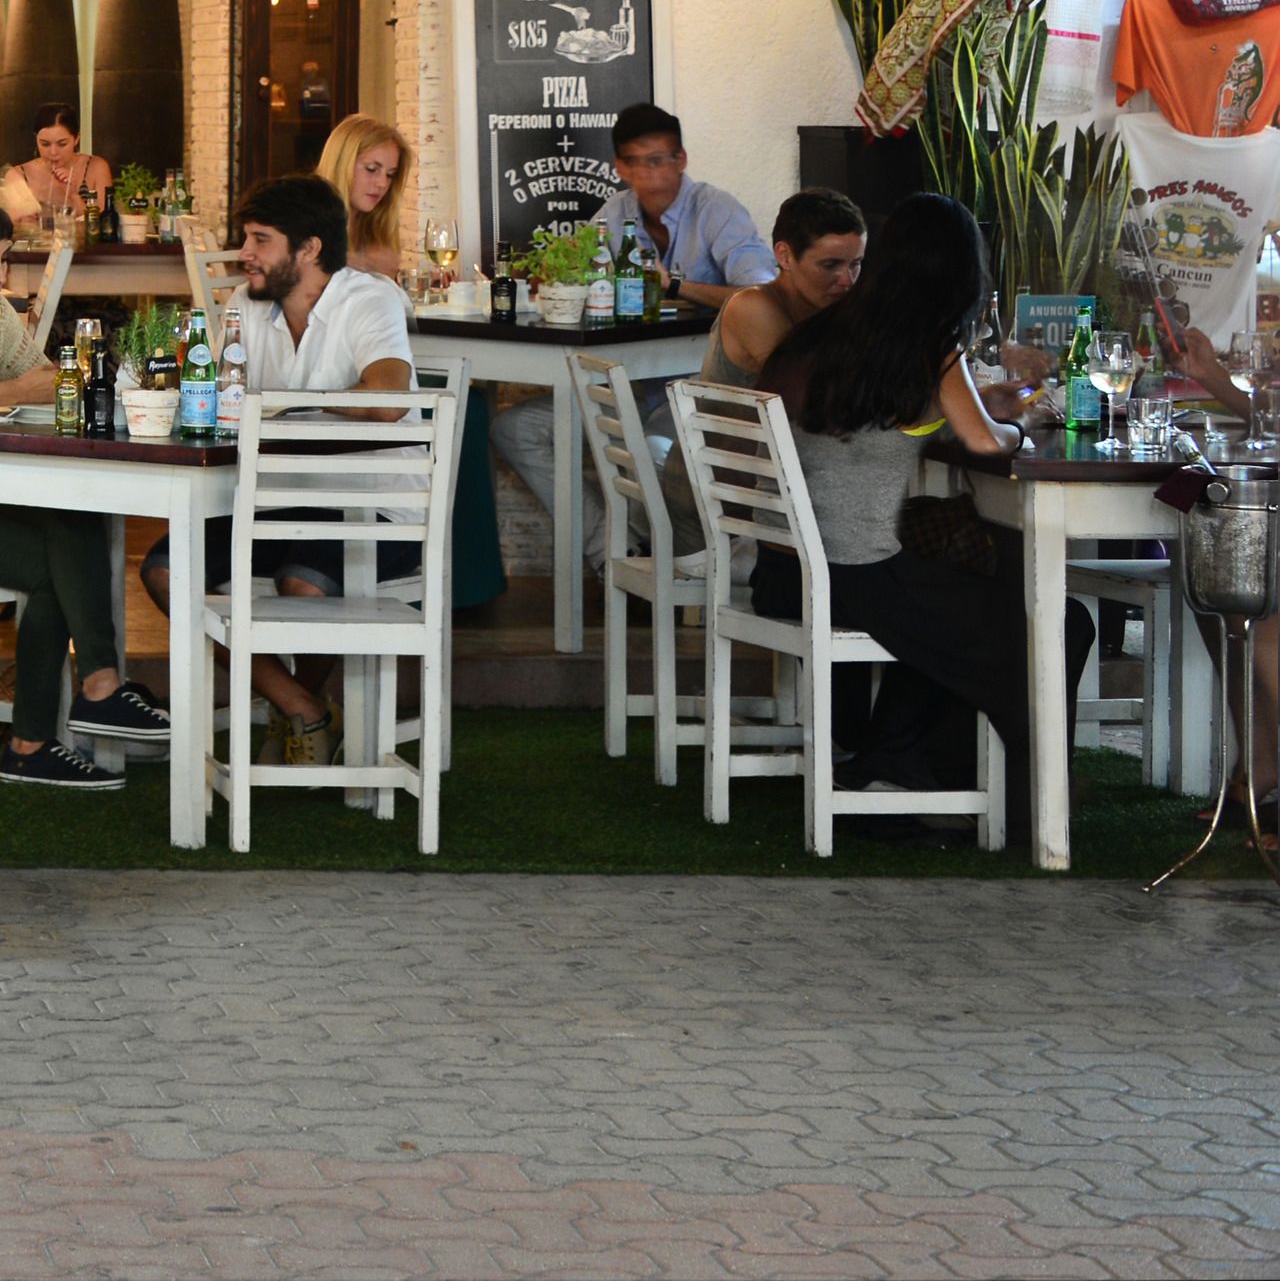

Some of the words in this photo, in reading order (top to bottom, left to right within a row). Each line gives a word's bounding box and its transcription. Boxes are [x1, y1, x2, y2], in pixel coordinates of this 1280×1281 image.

[507, 19, 548, 52] $185
[542, 76, 589, 108] PIZZA
[488, 114, 552, 130] PEPERONI
[523, 156, 621, 183] CERVEZAS
[528, 176, 617, 200] REFRESCOS
[1148, 181, 1188, 203] TRES
[1192, 179, 1253, 218] AMIGOS
[547, 201, 579, 211] POR
[1157, 263, 1213, 282] Cancun
